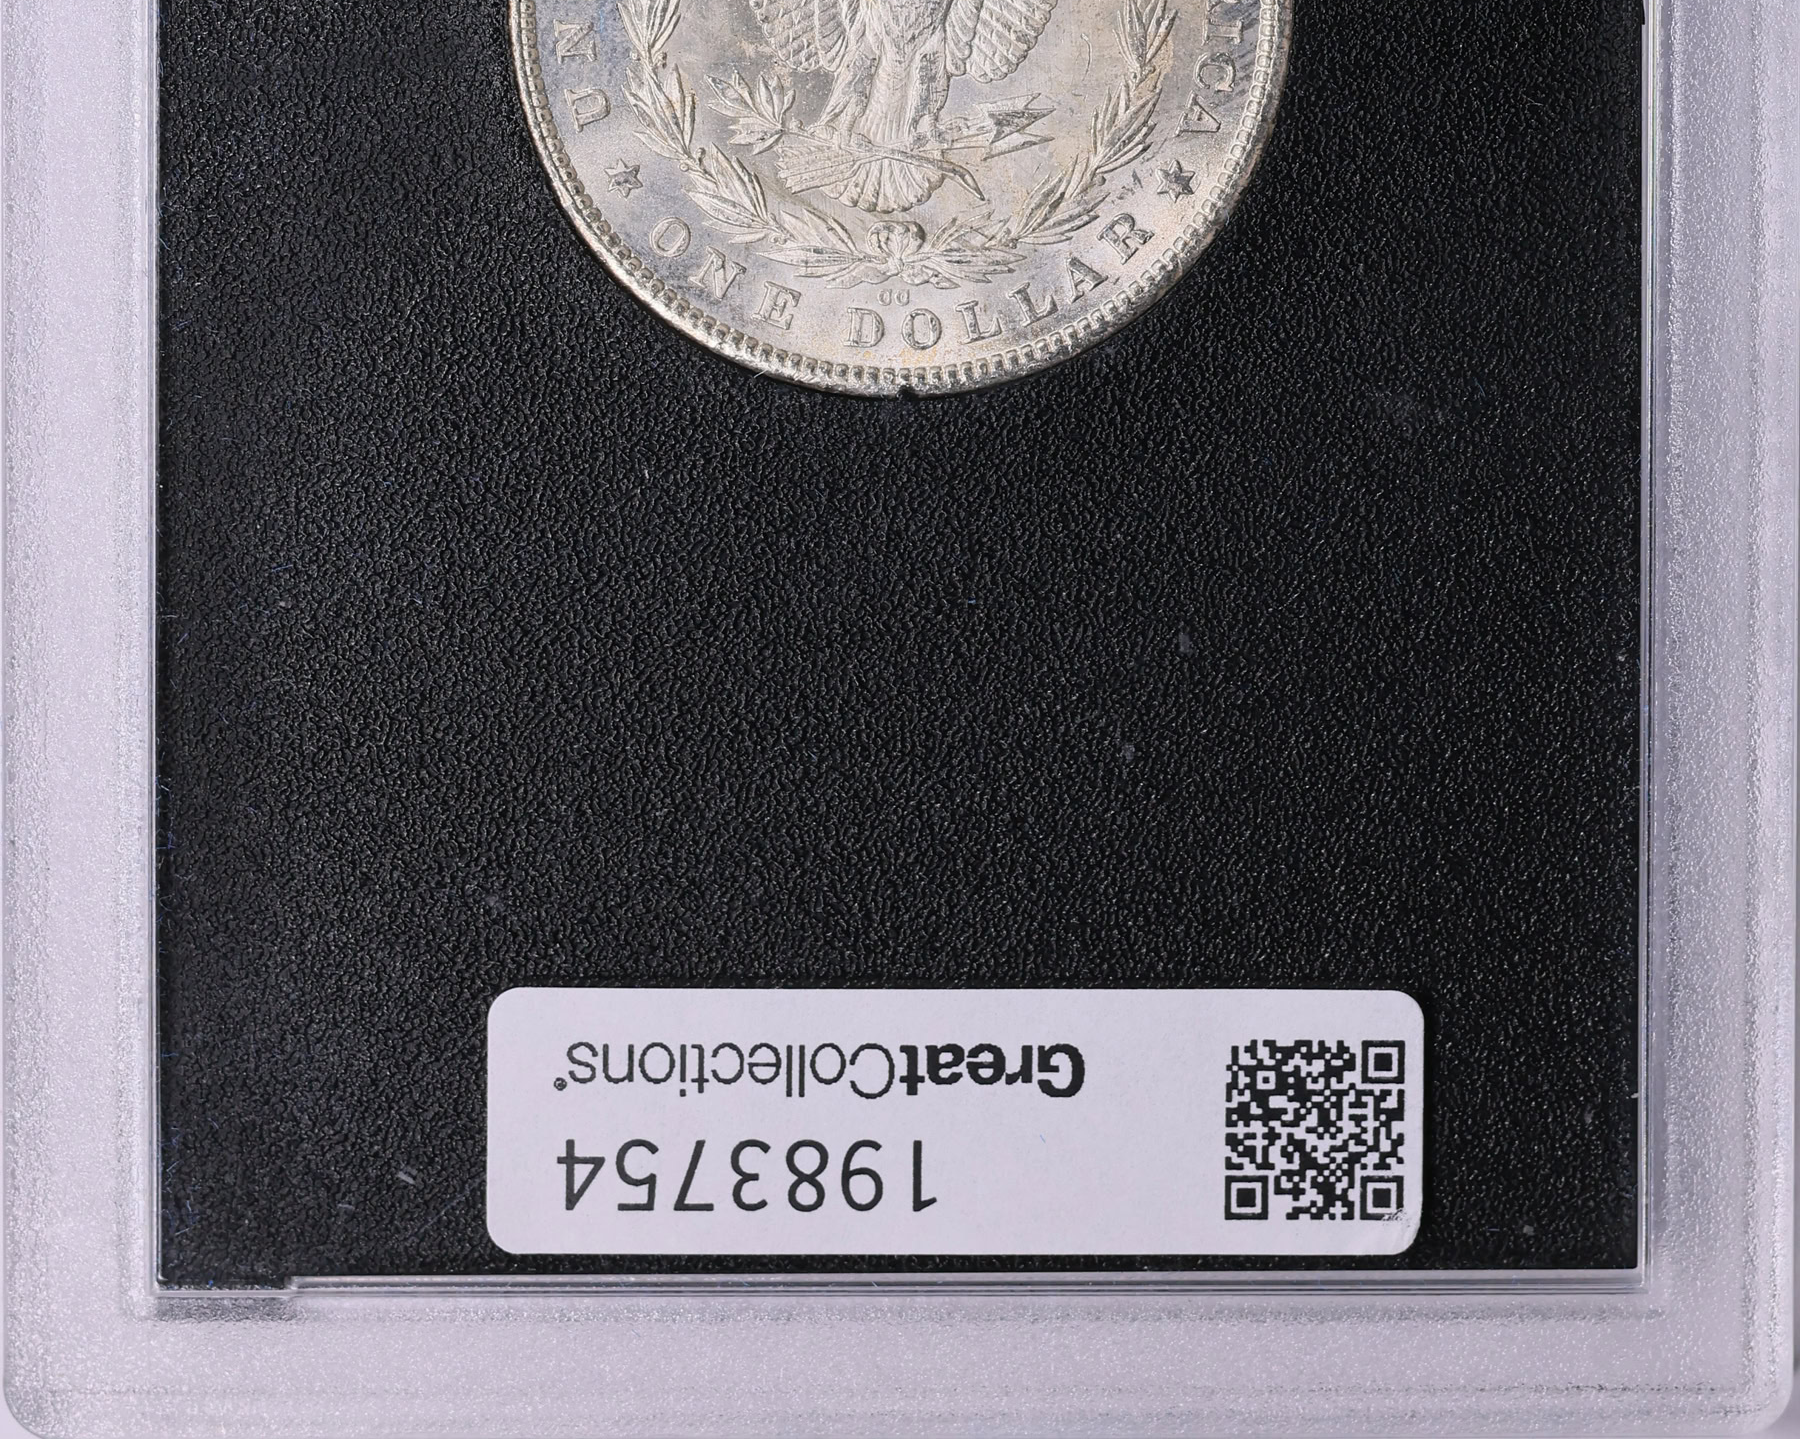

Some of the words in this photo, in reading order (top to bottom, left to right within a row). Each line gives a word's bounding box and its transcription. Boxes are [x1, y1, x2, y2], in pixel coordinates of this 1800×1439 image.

[649, 216, 802, 332] ONE
[842, 211, 1155, 351] DOLLAR
[556, 1138, 938, 1213] 1983754
